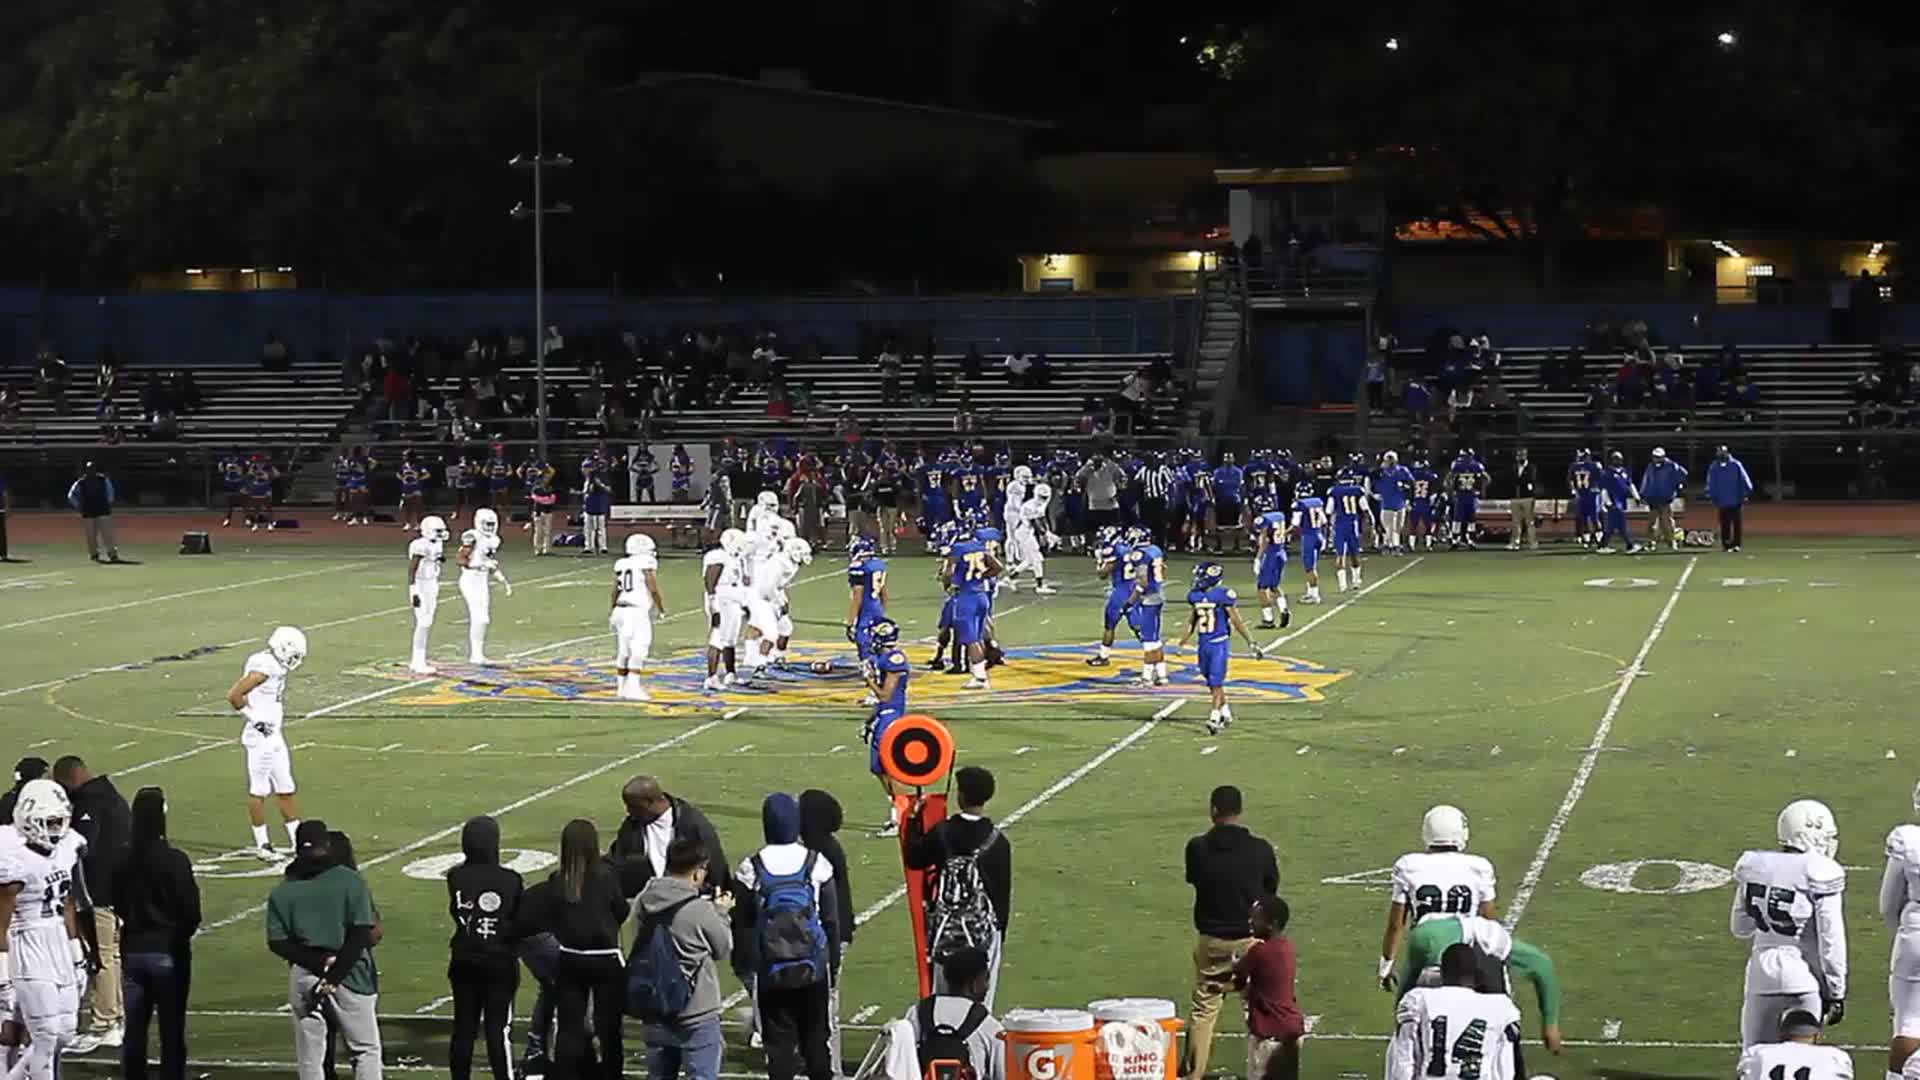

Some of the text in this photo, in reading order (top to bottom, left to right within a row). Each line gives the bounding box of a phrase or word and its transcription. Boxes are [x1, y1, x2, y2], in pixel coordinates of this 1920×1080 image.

[1198, 608, 1215, 633] 21
[1745, 882, 1796, 937] 55
[1026, 1048, 1057, 1080] G
[1426, 1014, 1488, 1080] 14
